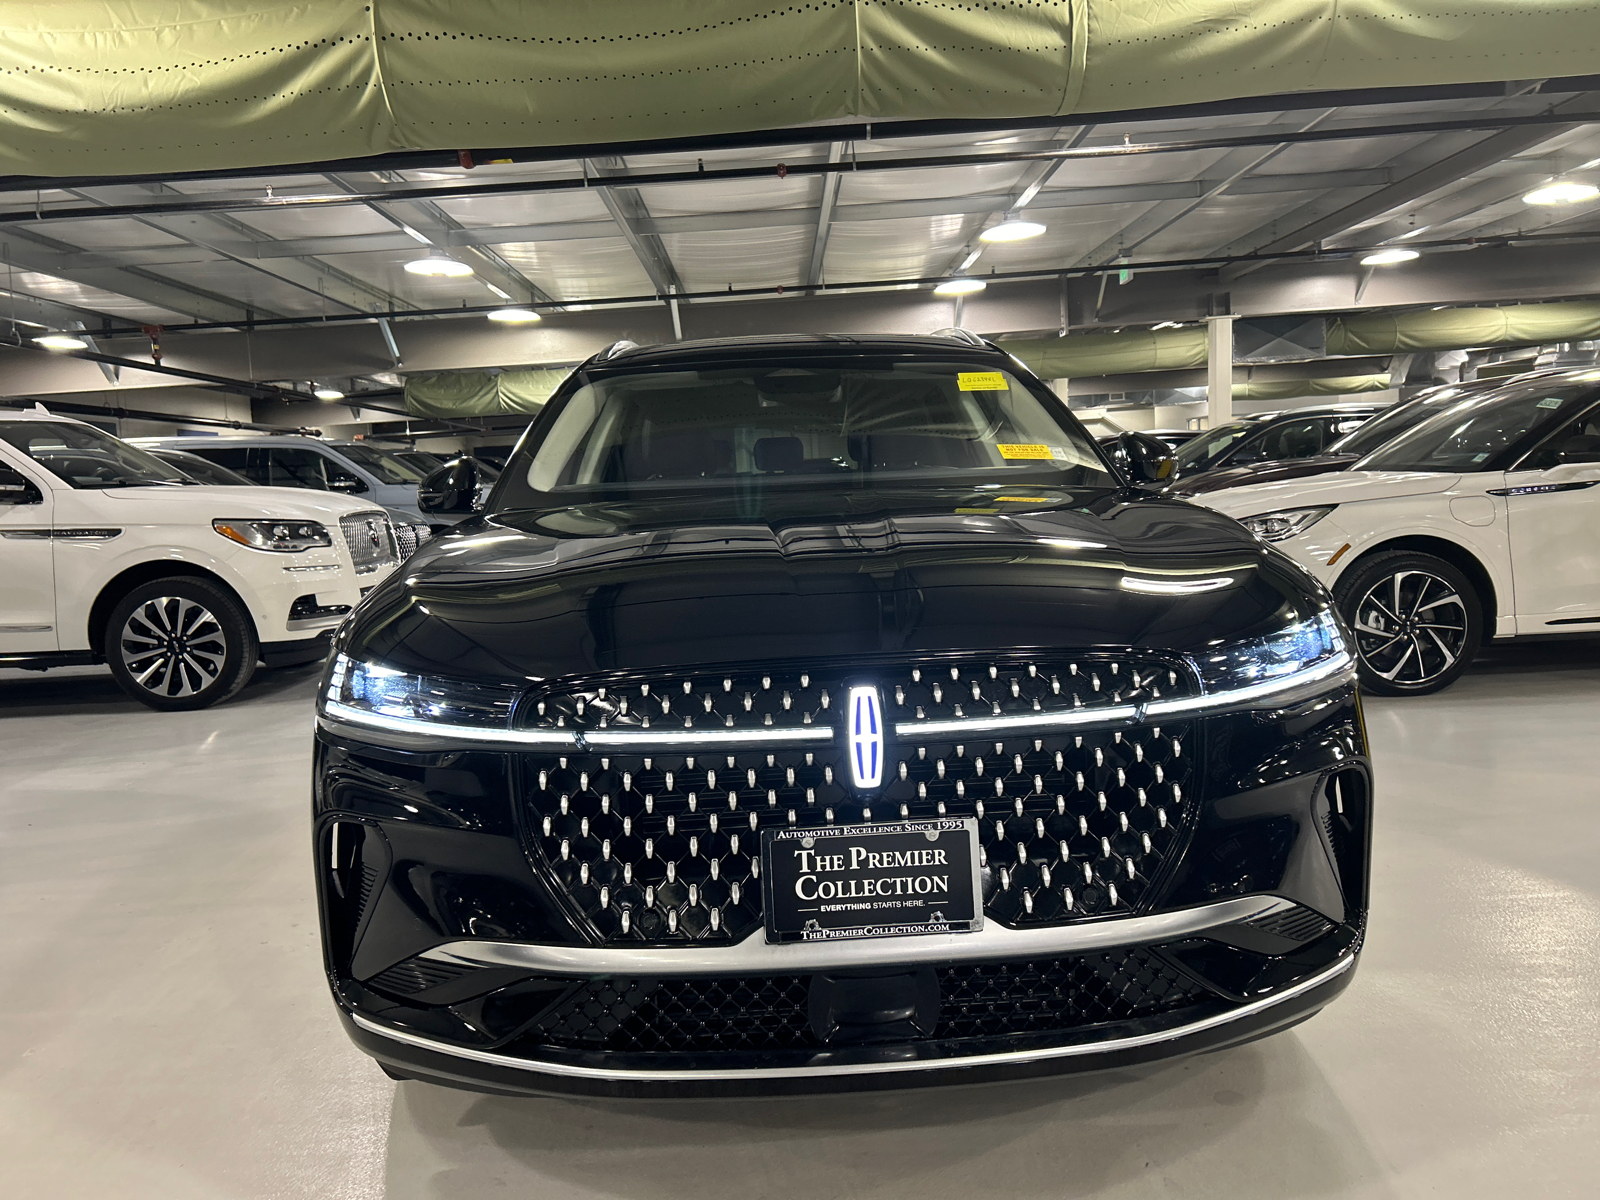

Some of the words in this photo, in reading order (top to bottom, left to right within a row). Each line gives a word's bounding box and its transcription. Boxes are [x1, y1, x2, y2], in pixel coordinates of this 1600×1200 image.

[777, 829, 841, 839] AUTOMOTIVE
[843, 825, 903, 836] EXCELLENCE
[904, 823, 933, 832] SINCE
[936, 820, 963, 830] 1995
[794, 849, 845, 873] THE
[848, 846, 948, 870] PREMIER
[795, 874, 949, 901] COLLECTION
[820, 902, 872, 912] EVERYTHING
[872, 900, 902, 909] STARTS
[902, 899, 926, 908] HERE.
[800, 924, 950, 940] THEPREMIERCOLLECTION.COM
